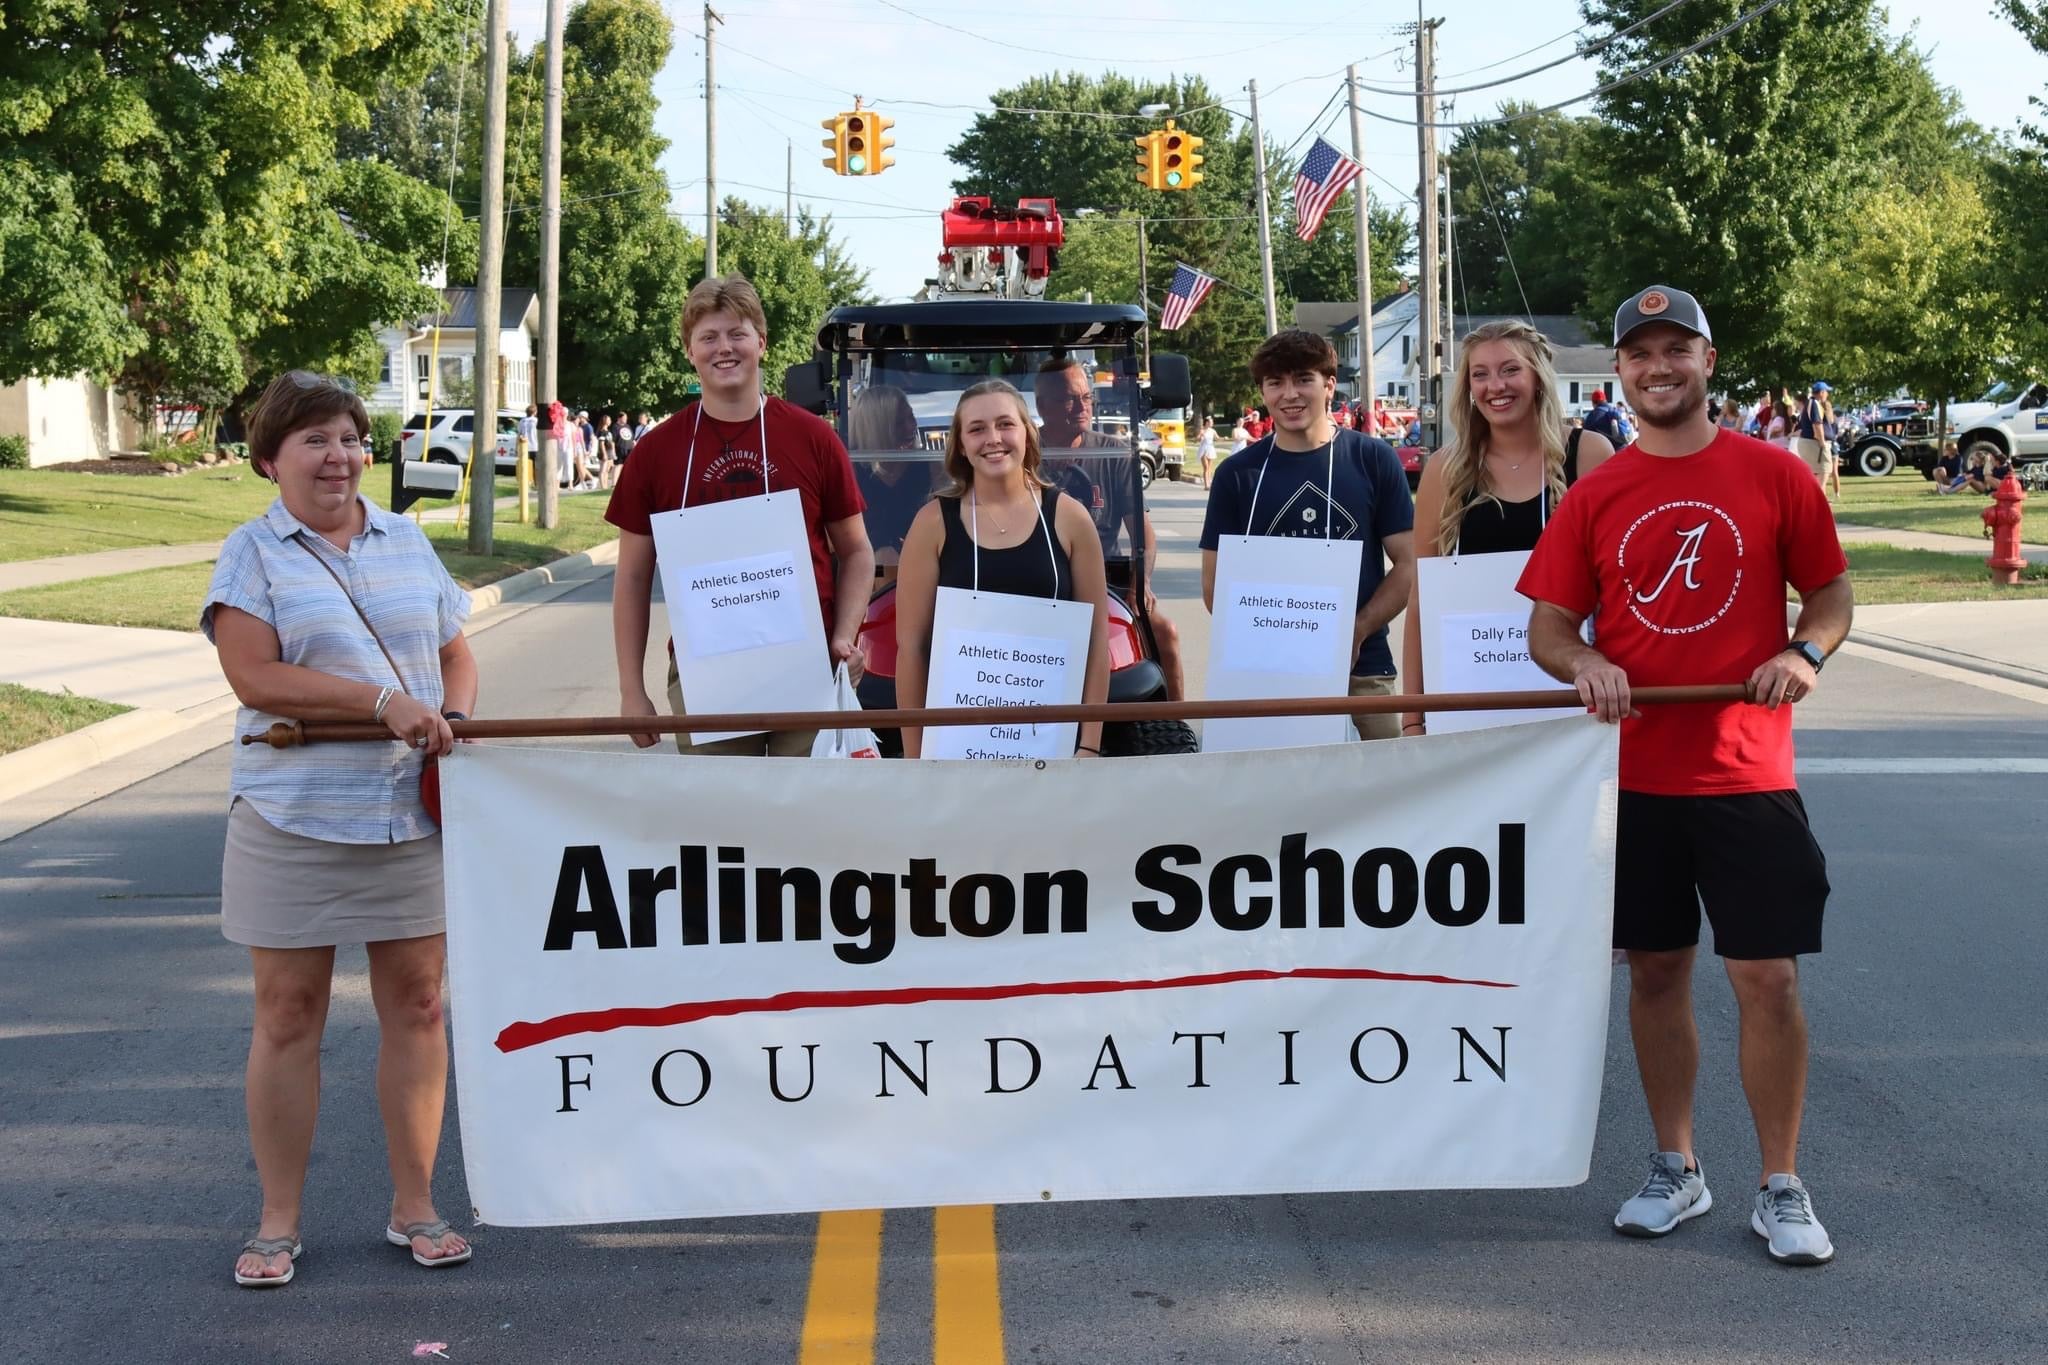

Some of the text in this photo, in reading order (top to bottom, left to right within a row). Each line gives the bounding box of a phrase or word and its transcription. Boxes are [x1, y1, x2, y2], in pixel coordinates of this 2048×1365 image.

[702, 449, 759, 482] INTERNATIONAL
[1618, 501, 1743, 567] ARLINGTON ATHLETIC BOOSTER
[1636, 521, 1709, 603] A
[691, 566, 794, 591] Athletic Boosters
[711, 588, 780, 609] Scholarship
[1239, 595, 1337, 611] Athletic Boosters
[1663, 616, 1718, 635] REVERSE
[1717, 569, 1742, 617] RAFFLE
[1253, 616, 1319, 632] Scholarship
[1471, 627, 1504, 642] Dally
[958, 644, 1065, 666] Athletic Boosters
[1473, 650, 1530, 663] Scholars
[977, 670, 1044, 688] Doc Castor
[989, 726, 1021, 741] Child
[542, 822, 1526, 965] Arlington School
[554, 1026, 1513, 1113] FOUNDATION
